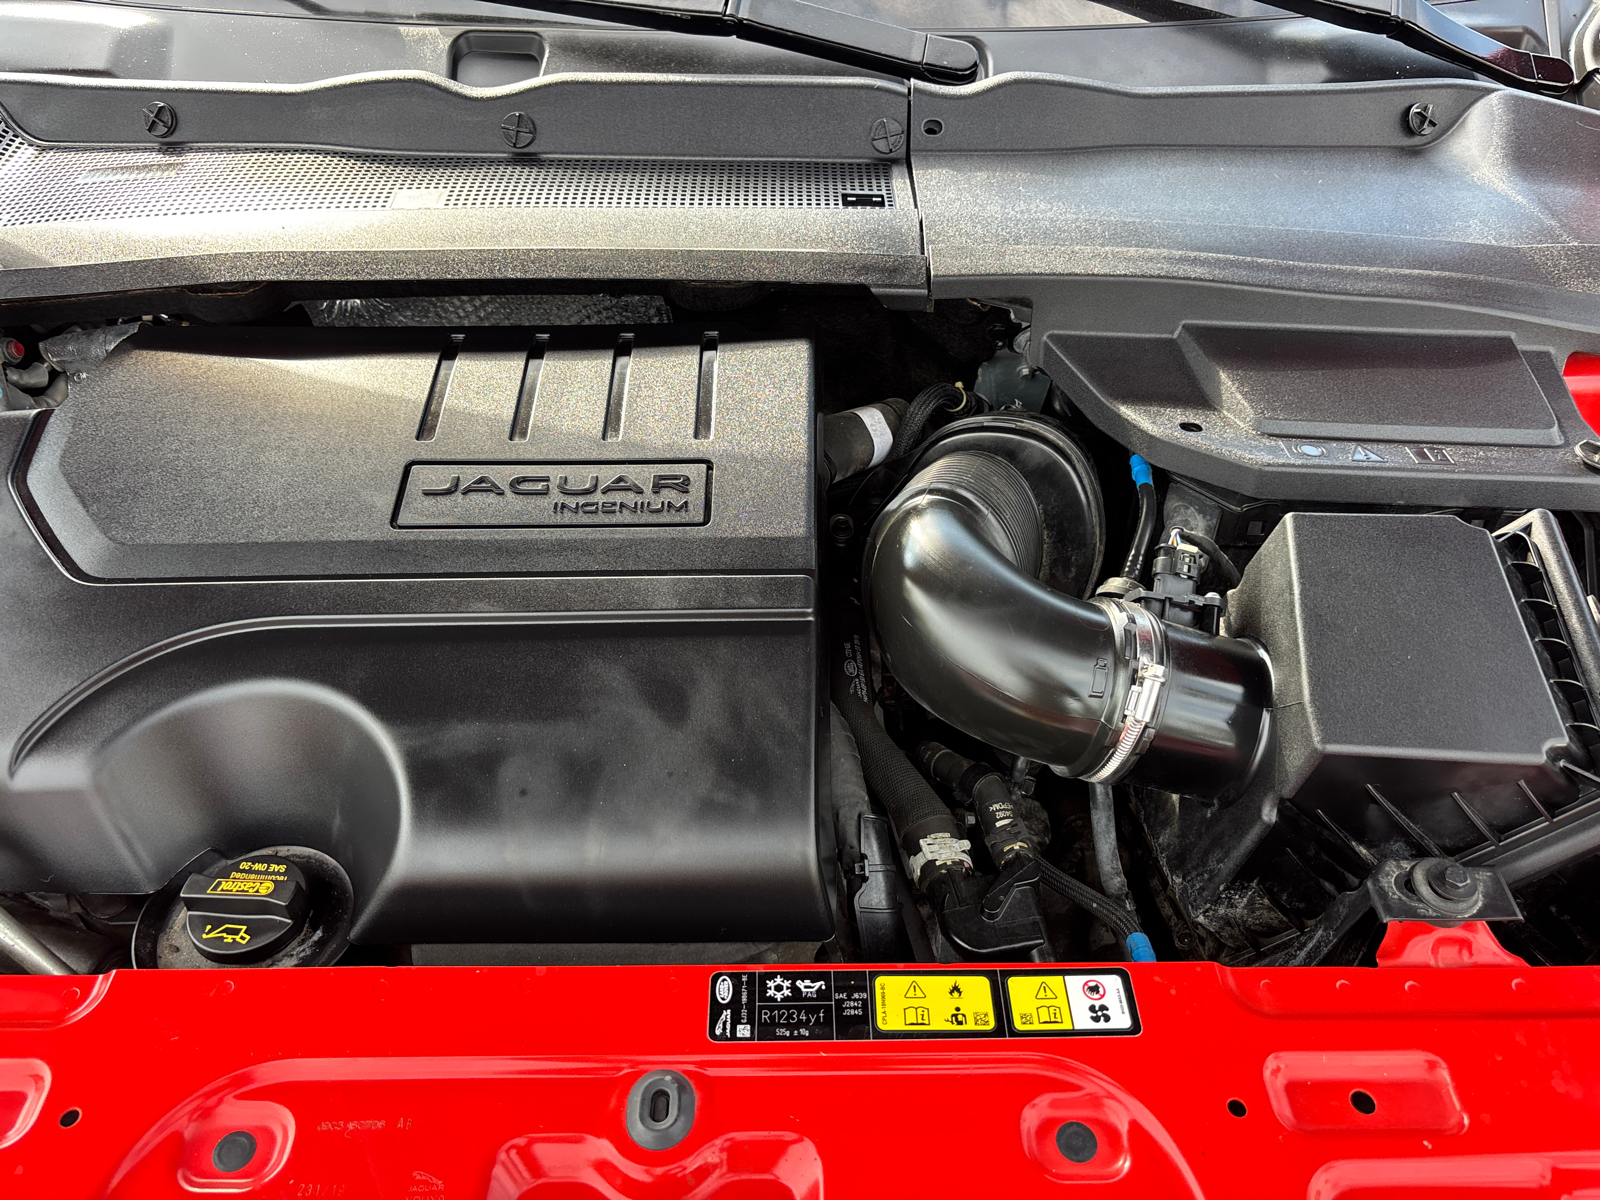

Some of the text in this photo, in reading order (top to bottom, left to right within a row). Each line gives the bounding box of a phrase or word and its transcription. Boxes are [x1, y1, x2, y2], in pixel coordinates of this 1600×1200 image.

[421, 474, 690, 495] JAGUAR
[552, 500, 689, 514] INGENIUM
[240, 862, 287, 872] SAE 0W-20
[217, 881, 260, 893] Castrol
[761, 1009, 825, 1025] R1234yf
[775, 1028, 790, 1037] 525g
[408, 1184, 445, 1192] JAGUAR
